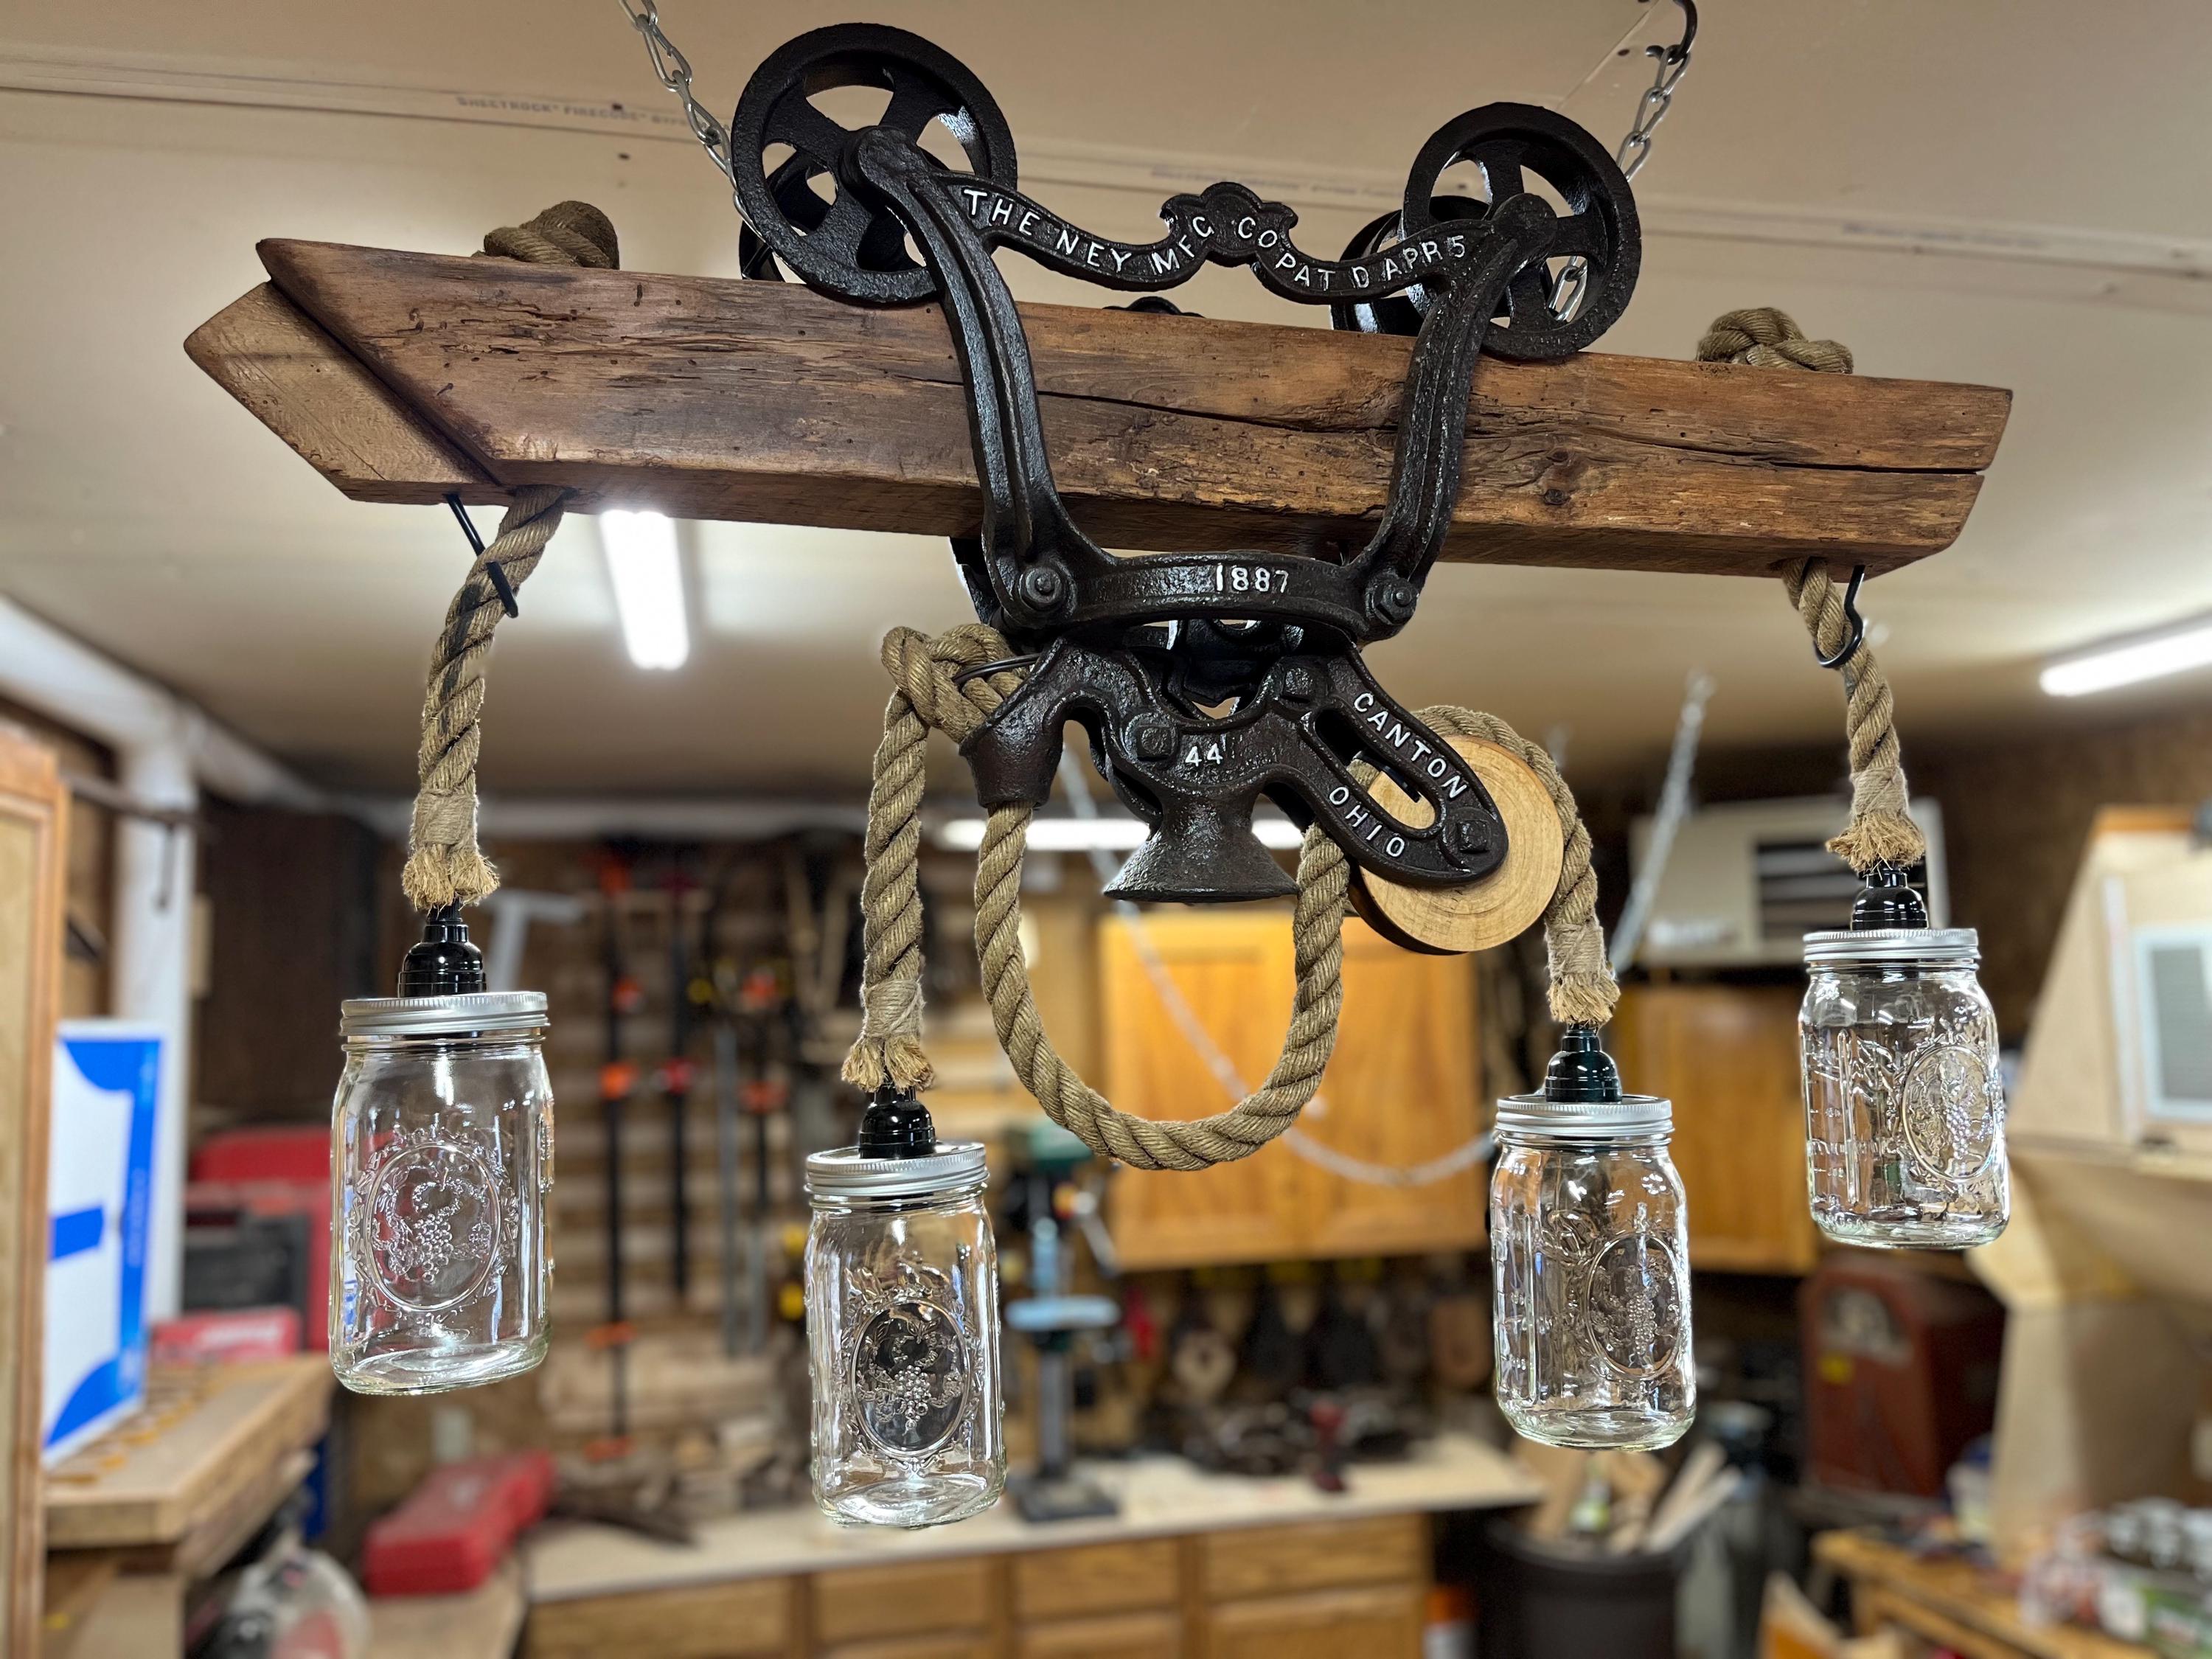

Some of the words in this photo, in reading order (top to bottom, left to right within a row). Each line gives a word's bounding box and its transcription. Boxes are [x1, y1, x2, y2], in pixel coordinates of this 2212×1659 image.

[963, 189, 1041, 236] THE
[1056, 229, 1132, 273] NEY
[1151, 216, 1215, 274] MFG
[1238, 216, 1278, 248] CO
[1274, 252, 1336, 291] PAT
[1383, 240, 1443, 281] APR
[1449, 235, 1466, 258] 5
[1215, 563, 1290, 593] 1887
[1184, 742, 1223, 768] 44
[1353, 692, 1468, 800] CANTON
[1329, 785, 1405, 858] OHIO
